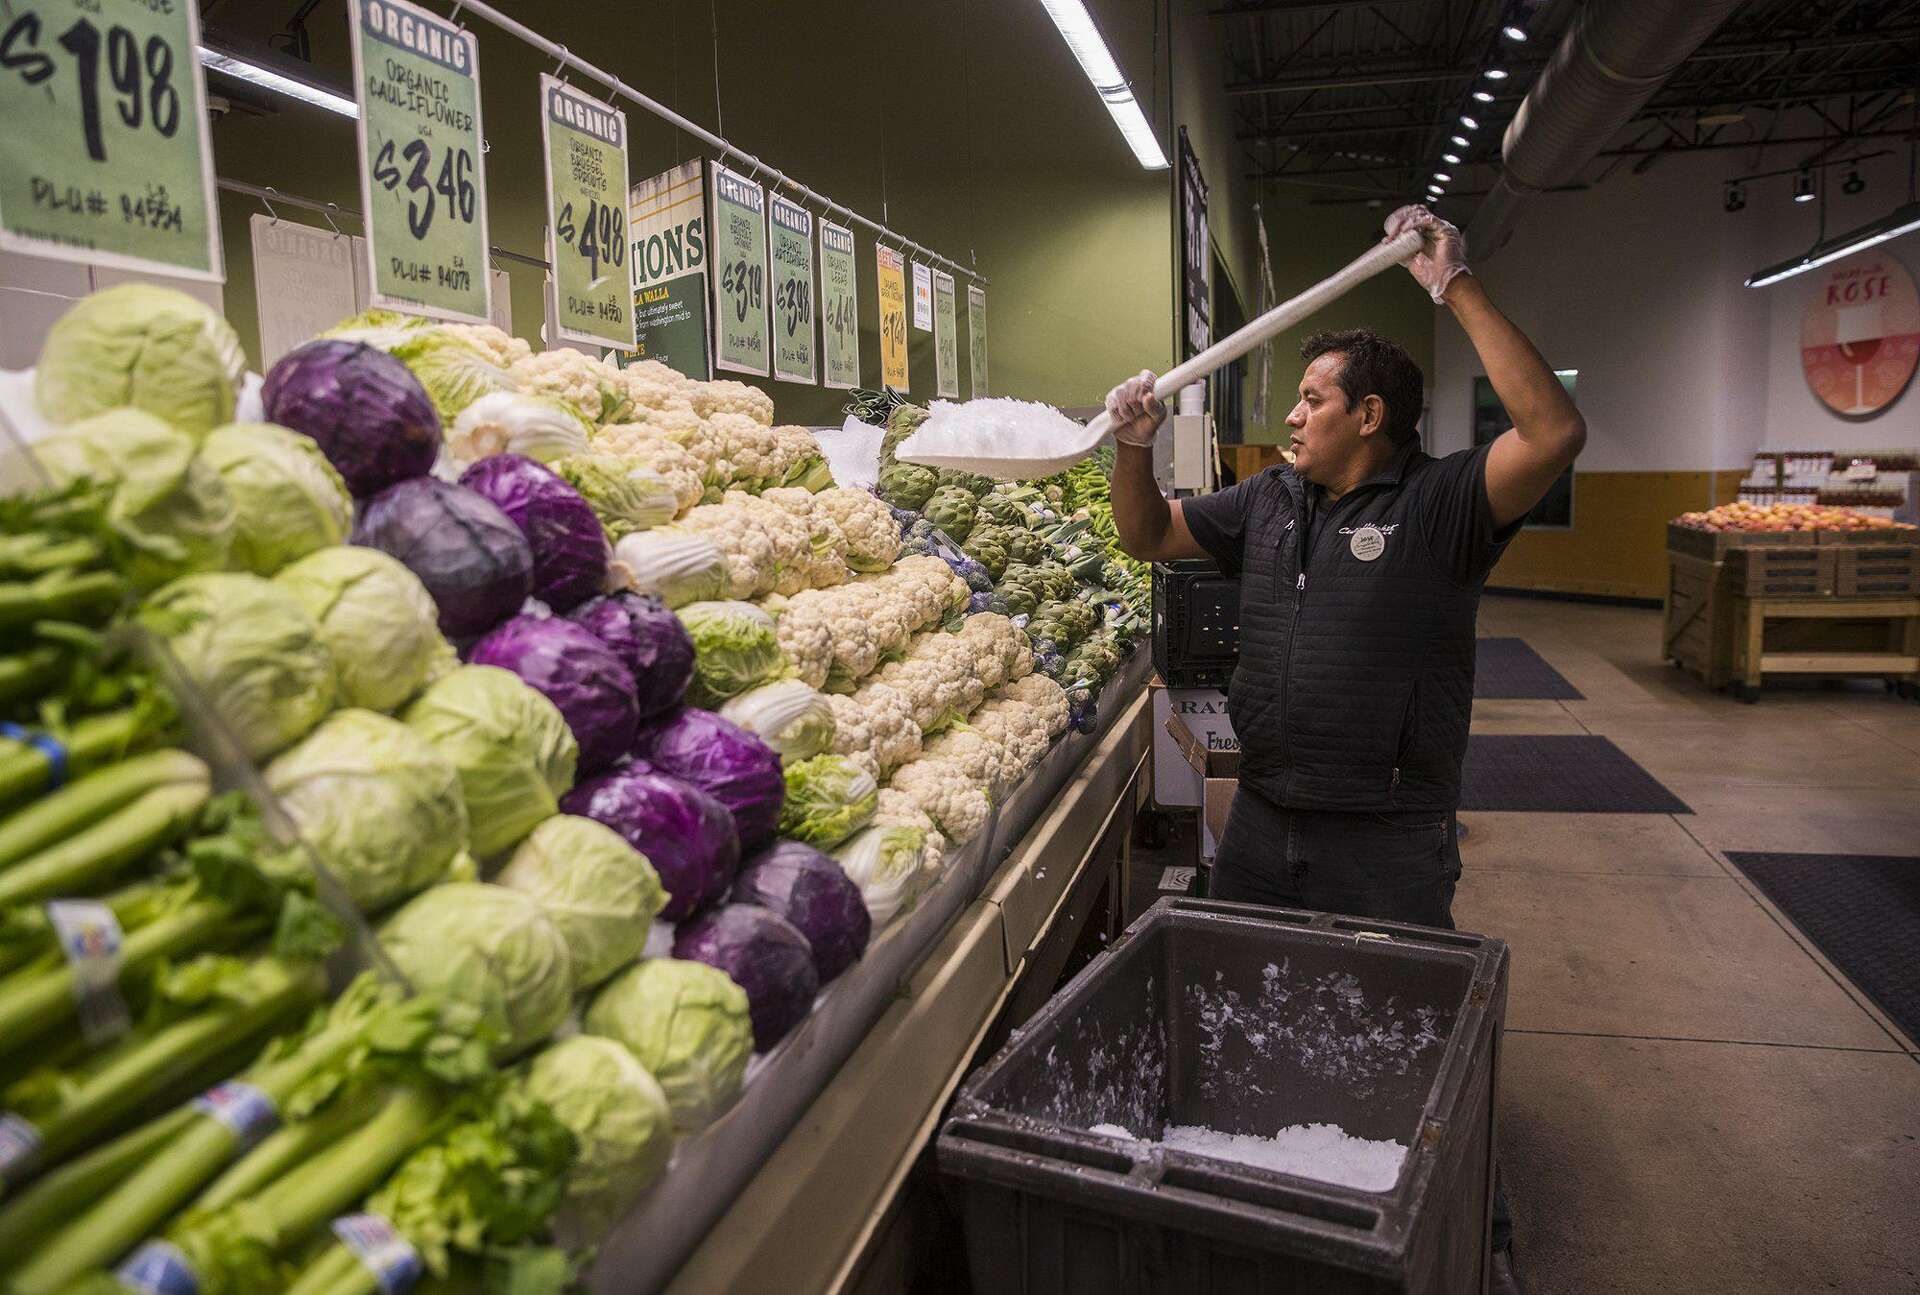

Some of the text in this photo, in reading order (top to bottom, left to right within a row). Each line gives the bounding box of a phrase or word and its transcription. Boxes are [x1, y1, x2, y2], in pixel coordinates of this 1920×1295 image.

[368, 2, 466, 69] ORGANIC
[0, 10, 181, 163] $198
[369, 75, 473, 132] CAULIFLOWER
[386, 58, 450, 102] ORGANIC
[553, 94, 618, 143] ORGANIC
[31, 177, 109, 217] PLU#
[373, 136, 477, 241] $346
[720, 177, 760, 211] ORGANIC
[556, 199, 624, 282] $498
[775, 204, 807, 233] ORGANIC
[391, 257, 431, 283] PLU#
[722, 257, 762, 323] $319
[776, 278, 810, 338] $398
